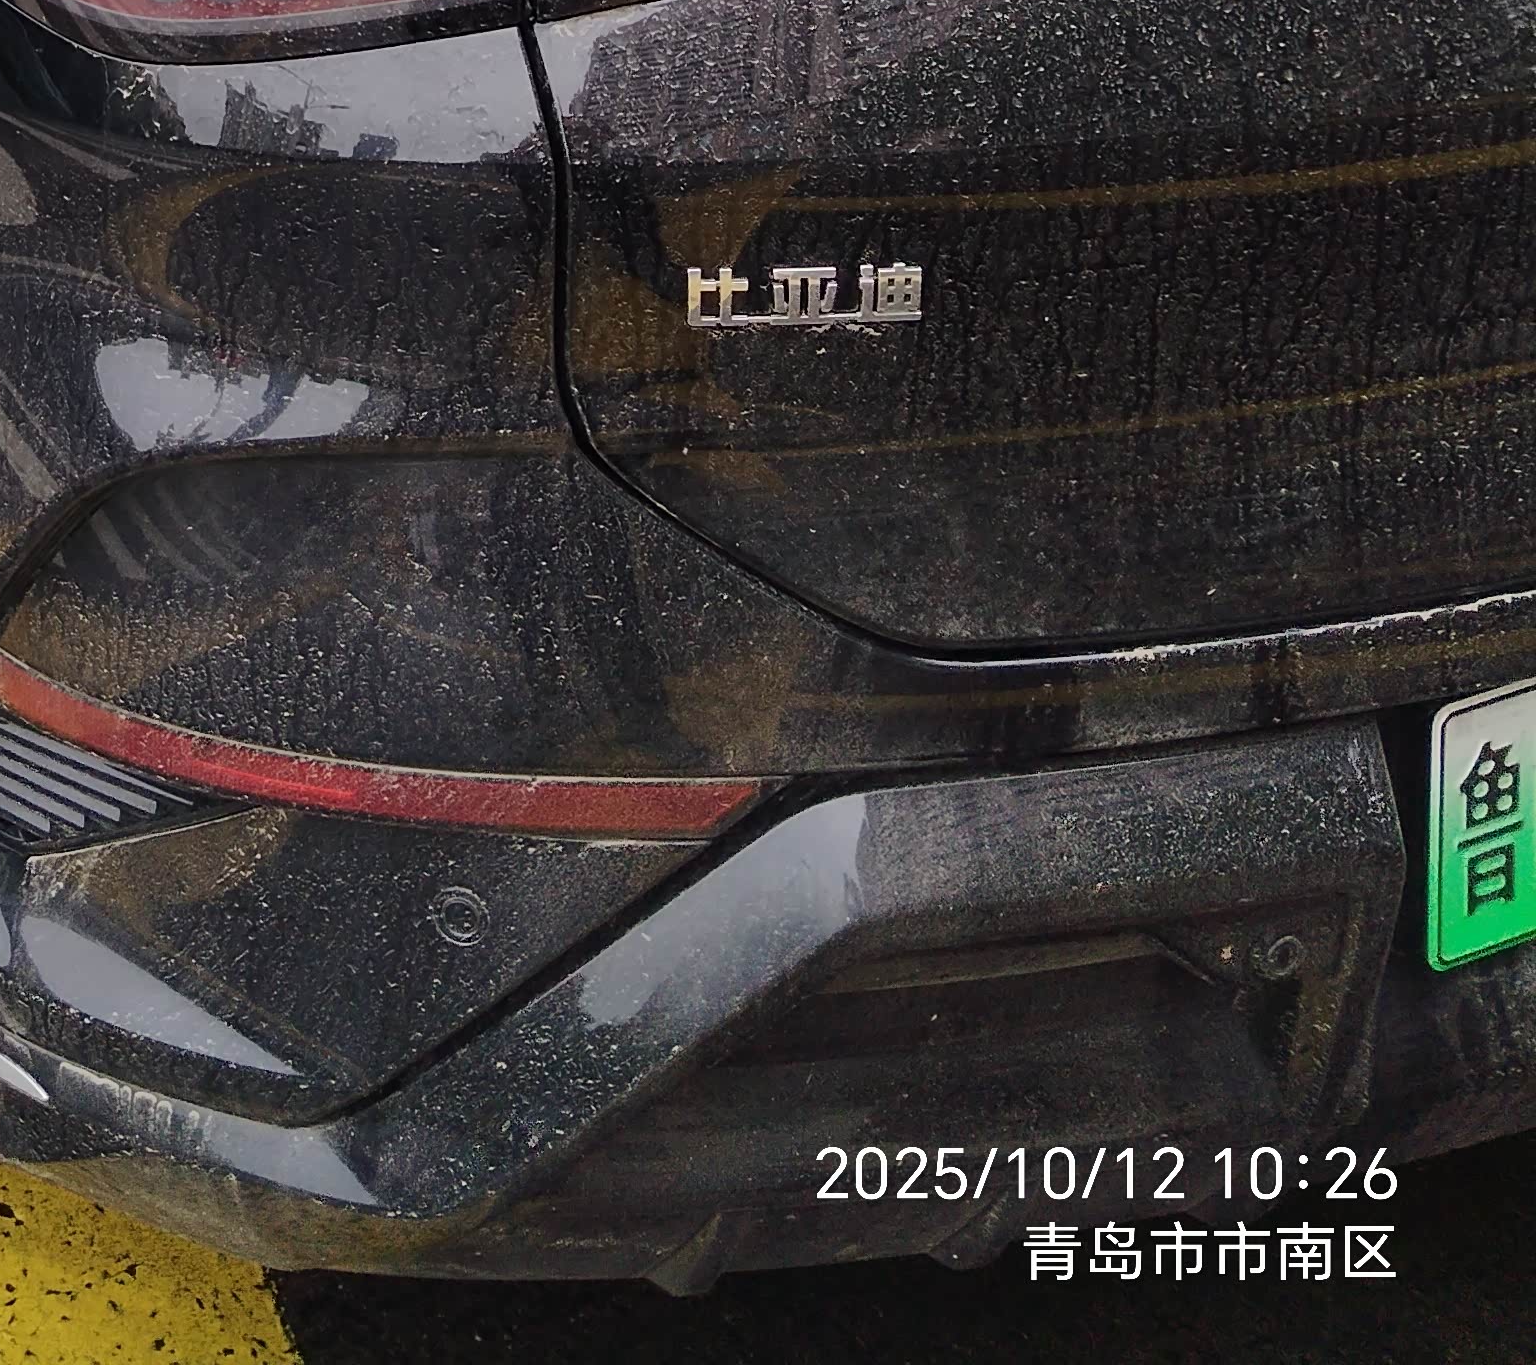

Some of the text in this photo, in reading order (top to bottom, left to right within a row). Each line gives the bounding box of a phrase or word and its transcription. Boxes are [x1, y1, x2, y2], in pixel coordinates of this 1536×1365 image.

[687, 262, 923, 325] 比亚迪
[1458, 740, 1525, 918] 鲁
